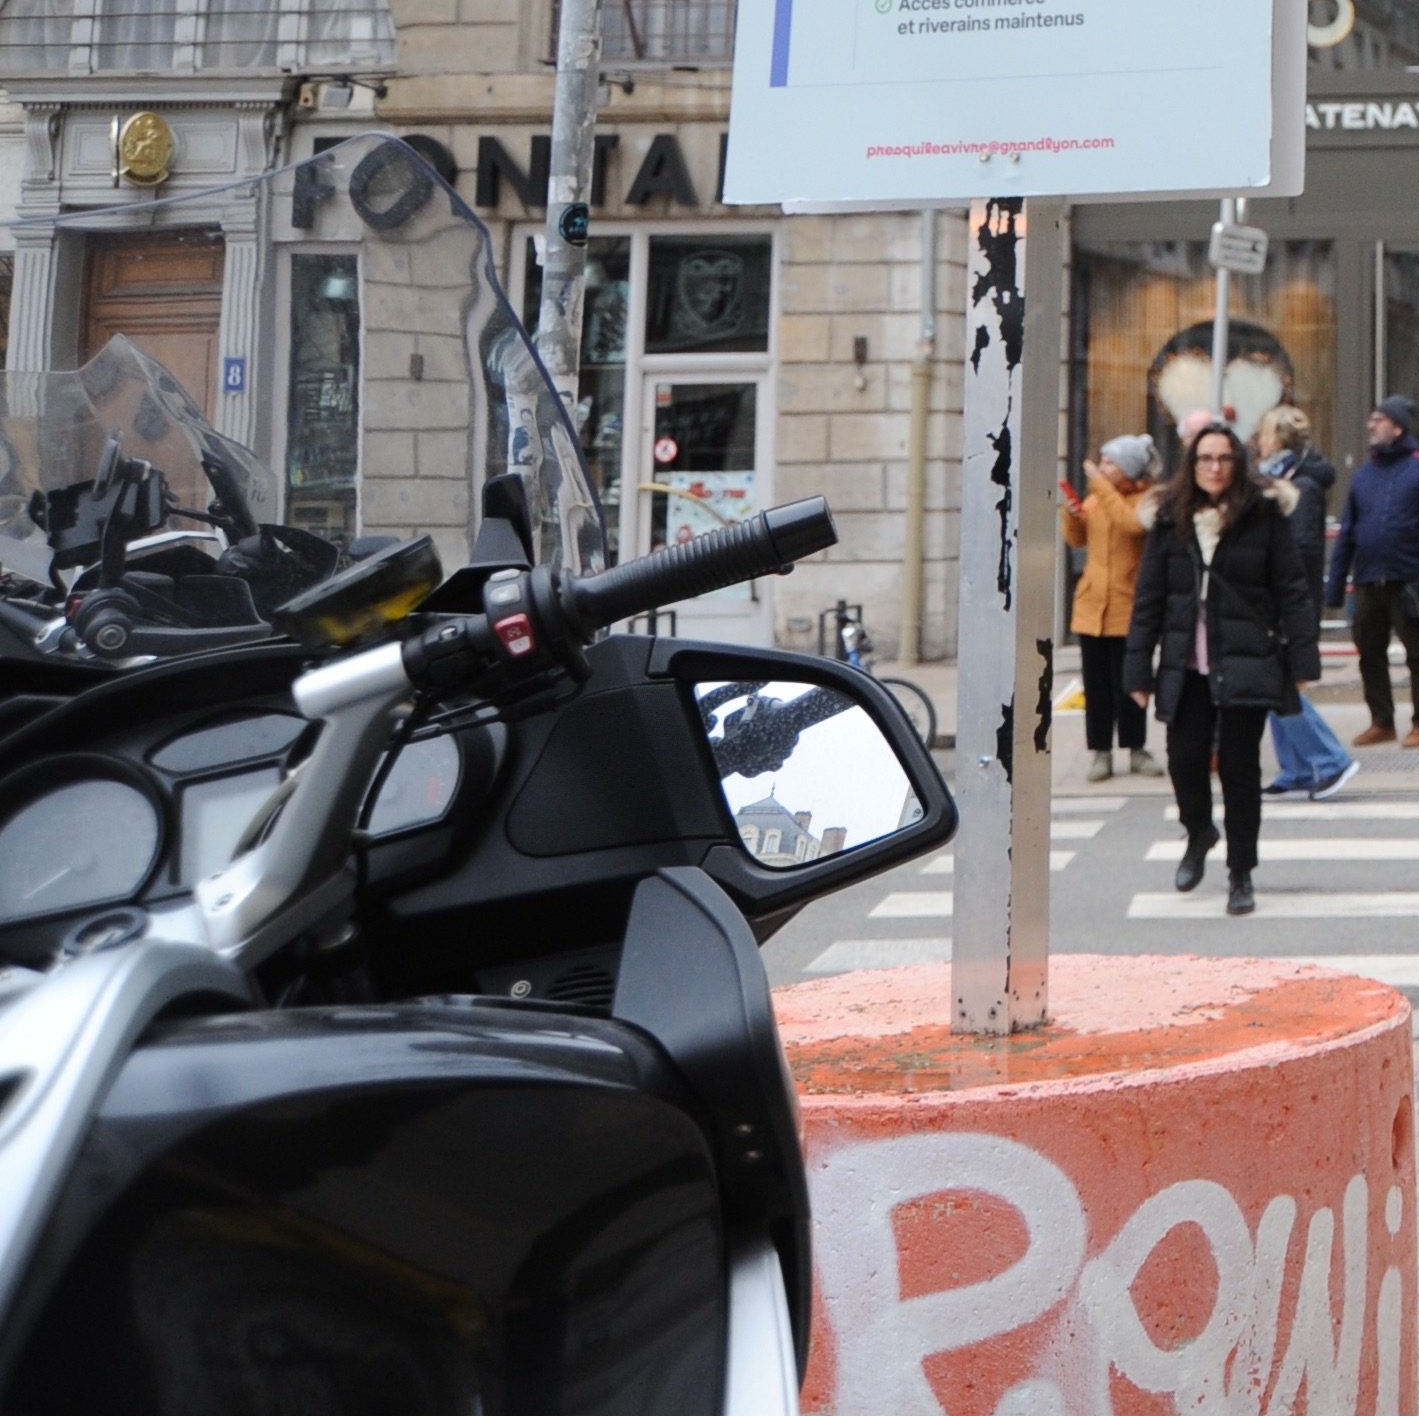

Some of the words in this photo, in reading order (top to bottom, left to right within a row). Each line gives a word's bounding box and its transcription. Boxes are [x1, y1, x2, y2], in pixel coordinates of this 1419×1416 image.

[897, 19, 915, 36] et
[918, 13, 991, 33] riverains
[994, 10, 1085, 29] maintenus
[866, 136, 1115, 160] presquileavivre@grandlyon.com
[226, 364, 243, 387] 8
